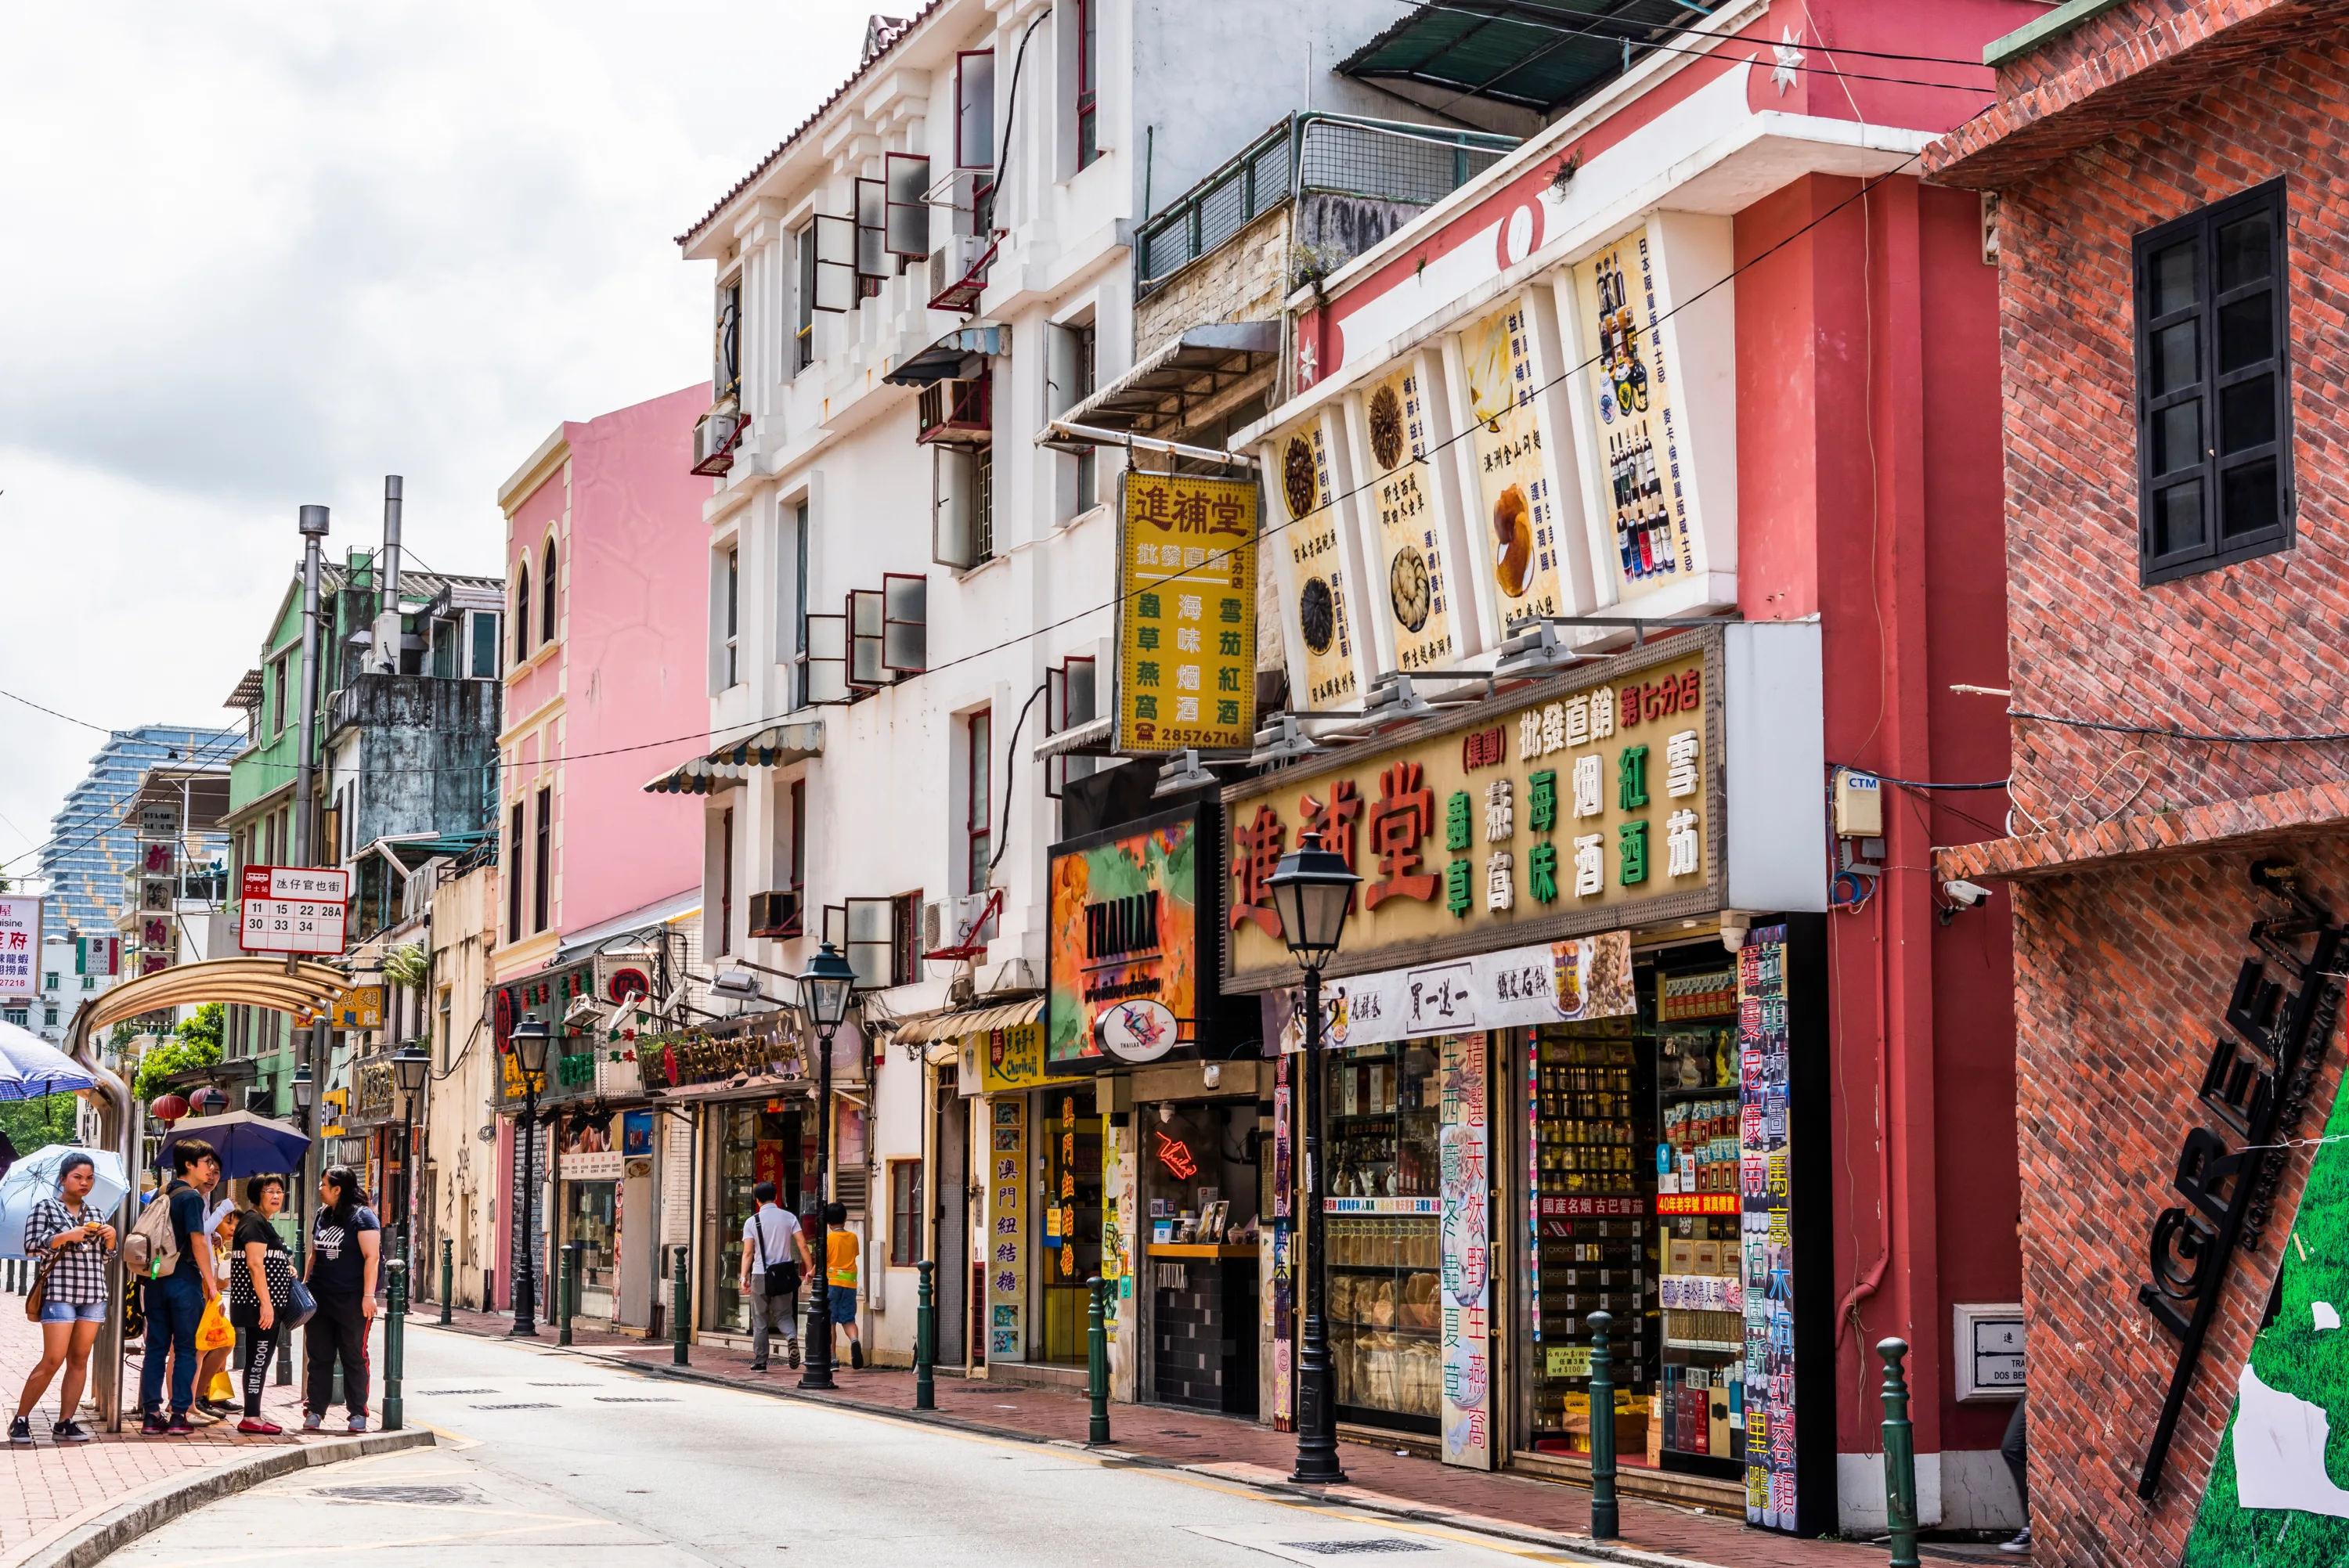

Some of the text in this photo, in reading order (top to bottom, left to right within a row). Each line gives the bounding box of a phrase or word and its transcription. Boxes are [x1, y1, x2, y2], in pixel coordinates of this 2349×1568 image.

[1639, 238, 1665, 384] 日本限量版威士忌
[1135, 485, 1247, 537] 進補堂
[1136, 543, 1229, 571] 批發直銷
[1519, 686, 1615, 761] 批發直銷
[1620, 669, 1701, 728] 第七分店
[1162, 728, 1239, 745] 28576716
[1666, 730, 1699, 878] 雪茄
[1849, 777, 1877, 788] CTM
[1528, 770, 1558, 904] 海味
[1618, 745, 1649, 886] 紅酒
[1445, 791, 1472, 917] 蟲草
[1485, 780, 1514, 913] 燕窩
[252, 903, 262, 913] 11
[276, 878, 340, 892] 氹仔官也街
[276, 904, 287, 914] 15
[300, 905, 314, 915] 22
[249, 919, 263, 929] 30
[275, 920, 288, 931] 33
[299, 921, 312, 932] 34
[322, 907, 341, 917] 28A
[1084, 890, 1159, 959] THAILAX
[333, 989, 380, 1008] 魚翅
[1410, 978, 1469, 1020] 買一送一
[1763, 941, 1784, 1034] 拉菲
[992, 1032, 1001, 1061] 正牌
[1741, 945, 1762, 1195] 羅曼尼康帝
[996, 1159, 1019, 1292] 澳門紐結糖
[1596, 1199, 1643, 1213] 古巴雪茄
[1659, 1197, 1699, 1212] 40年老字號
[1703, 1196, 1734, 1212] 貨真價實
[1767, 1156, 1789, 1247] 馬高
[1467, 1033, 1485, 1450] 精選天然野生燕窩
[1745, 1236, 1766, 1380] 柏圖斯
[1770, 1260, 1792, 1354] 木桐
